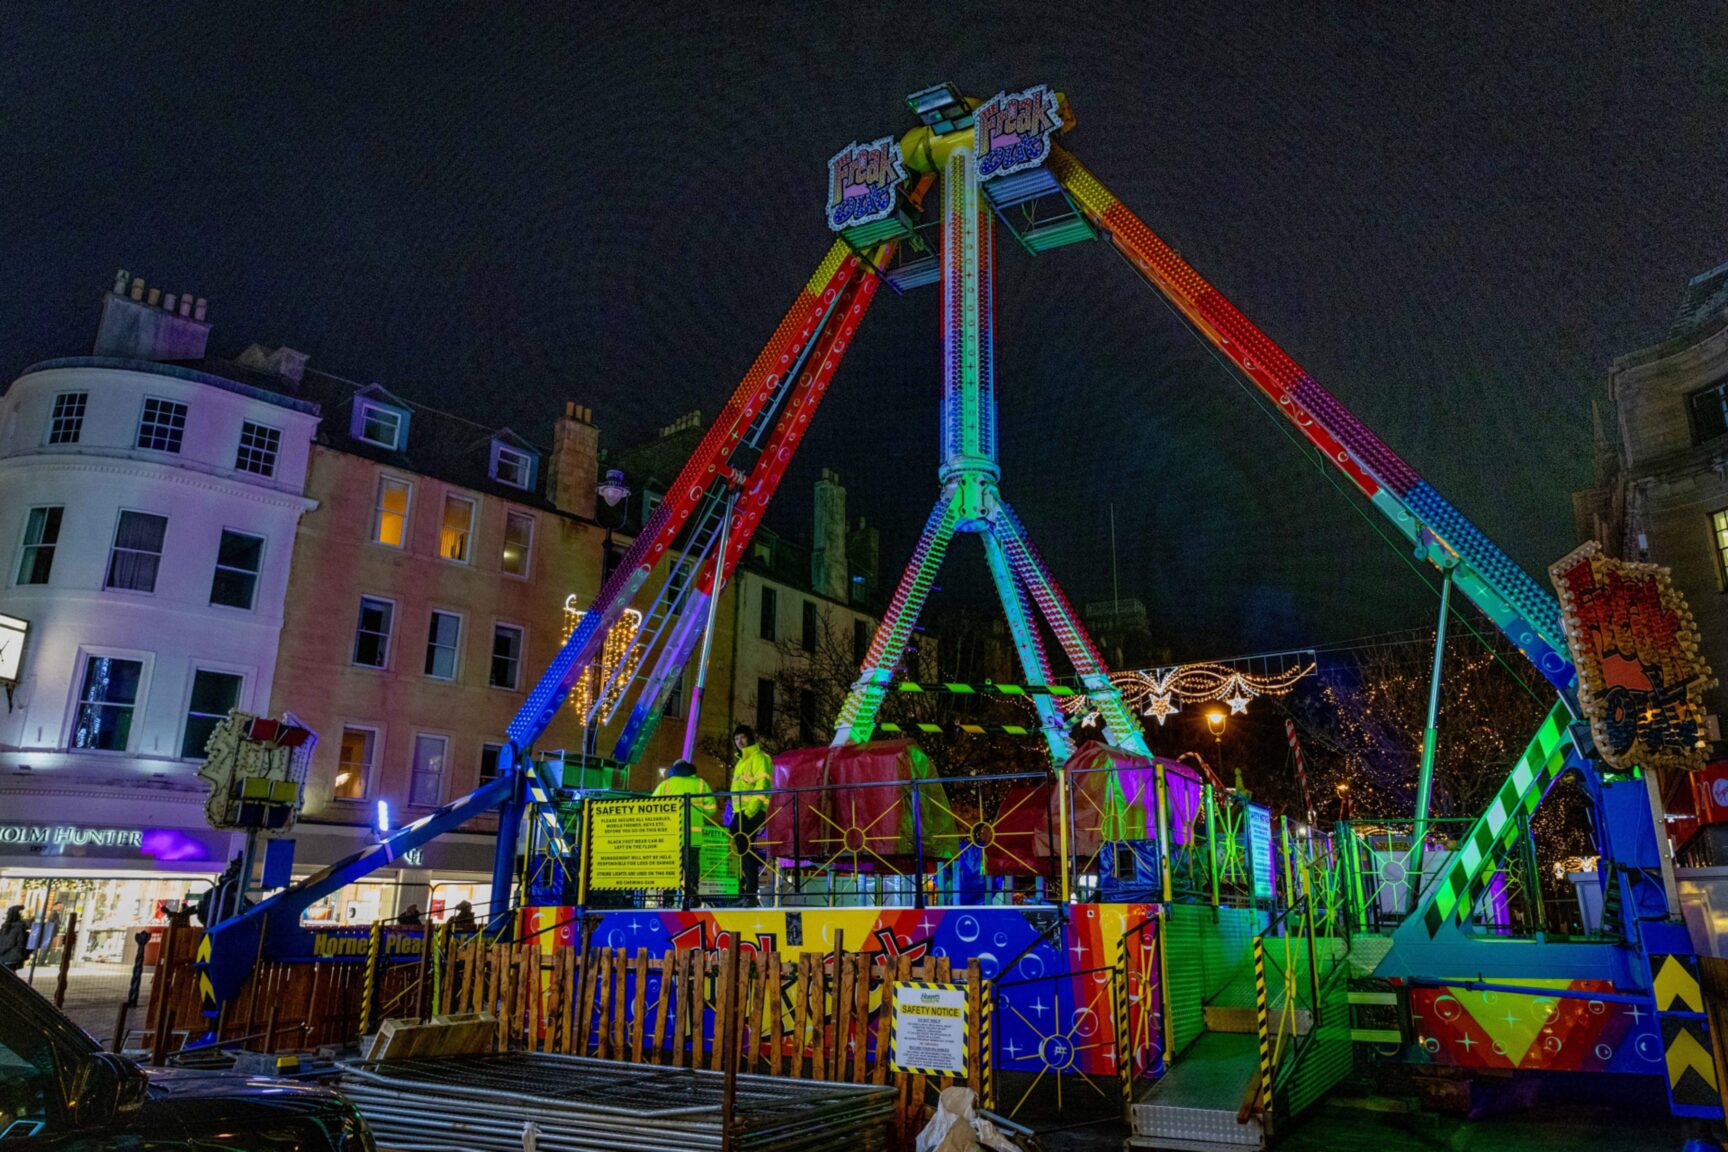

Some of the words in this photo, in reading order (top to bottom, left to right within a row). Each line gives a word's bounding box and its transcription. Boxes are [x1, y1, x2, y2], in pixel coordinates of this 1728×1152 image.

[977, 90, 1055, 159] Freak
[832, 142, 899, 208] Freak
[596, 805, 634, 816] SAFETY
[638, 804, 677, 814] NOTICE
[0, 826, 48, 843] OLM
[54, 826, 143, 850] HUNTER
[313, 933, 369, 955] Horne
[902, 1004, 930, 1014] SAFETY
[931, 1007, 959, 1016] NOTICE
